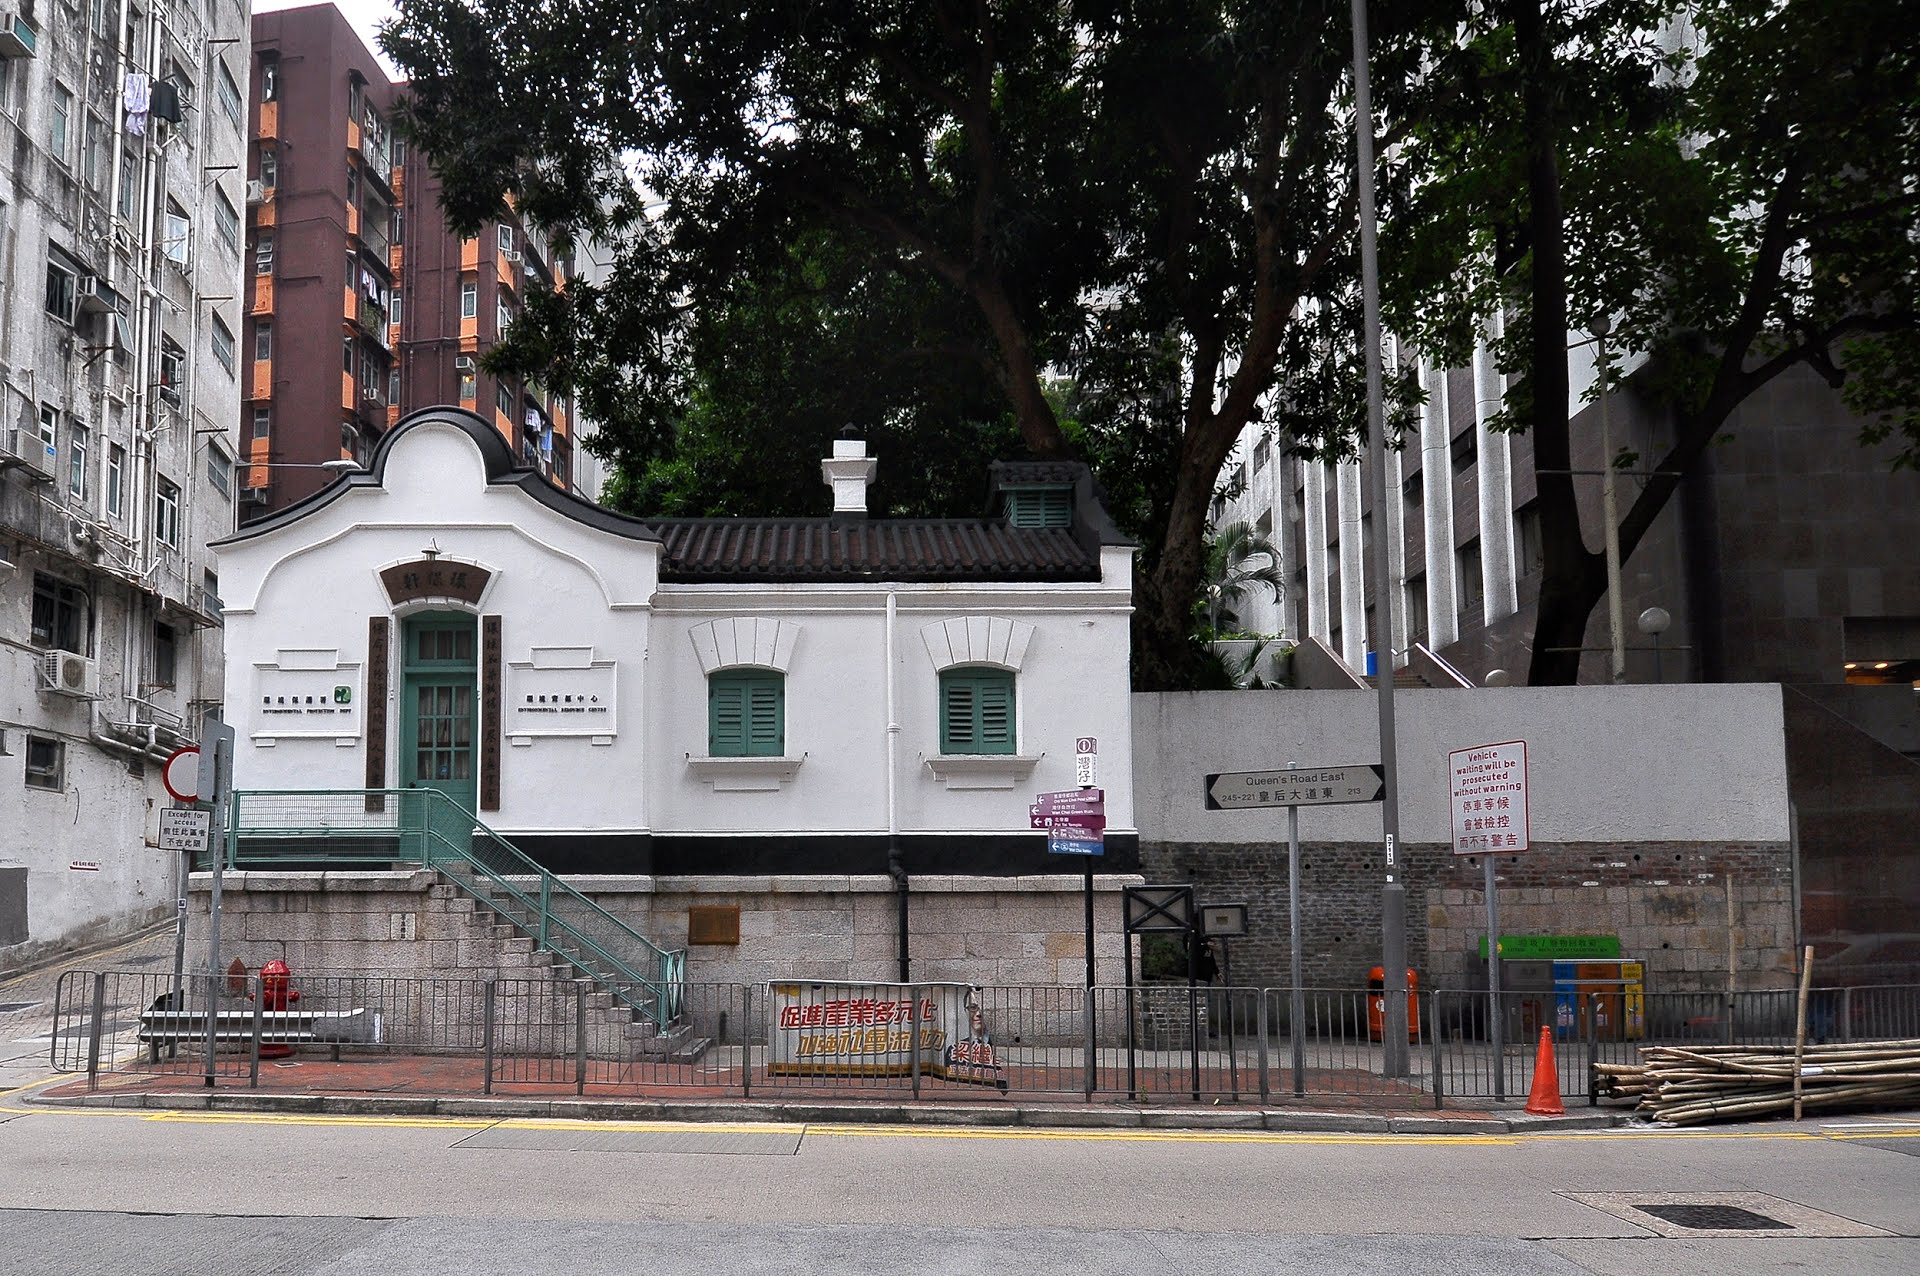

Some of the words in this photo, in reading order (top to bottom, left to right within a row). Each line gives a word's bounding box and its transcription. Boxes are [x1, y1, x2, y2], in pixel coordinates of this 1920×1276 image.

[1468, 751, 1498, 762] Vehicle
[1078, 756, 1091, 783] 灣仔
[1456, 764, 1484, 776] waiting
[1484, 761, 1502, 771] will
[1504, 760, 1516, 768] be
[1246, 775, 1288, 786] Queen's
[1290, 774, 1319, 784] Road
[1321, 772, 1345, 782] East
[1462, 771, 1509, 787] prosecuted
[1222, 794, 1256, 802] 245-221
[1259, 786, 1334, 803] 皇后大道東
[1347, 787, 1361, 795] 213
[1453, 786, 1482, 798] without
[1483, 782, 1522, 794] warning
[1463, 796, 1510, 814] 停車等候
[168, 811, 191, 819] Except
[1464, 814, 1510, 831] 會被檢控
[167, 838, 201, 848] 不在此限
[1459, 832, 1518, 849] 而不予警告
[780, 998, 939, 1030] 促進產業多元化
[950, 1041, 1002, 1066] 梁繼
